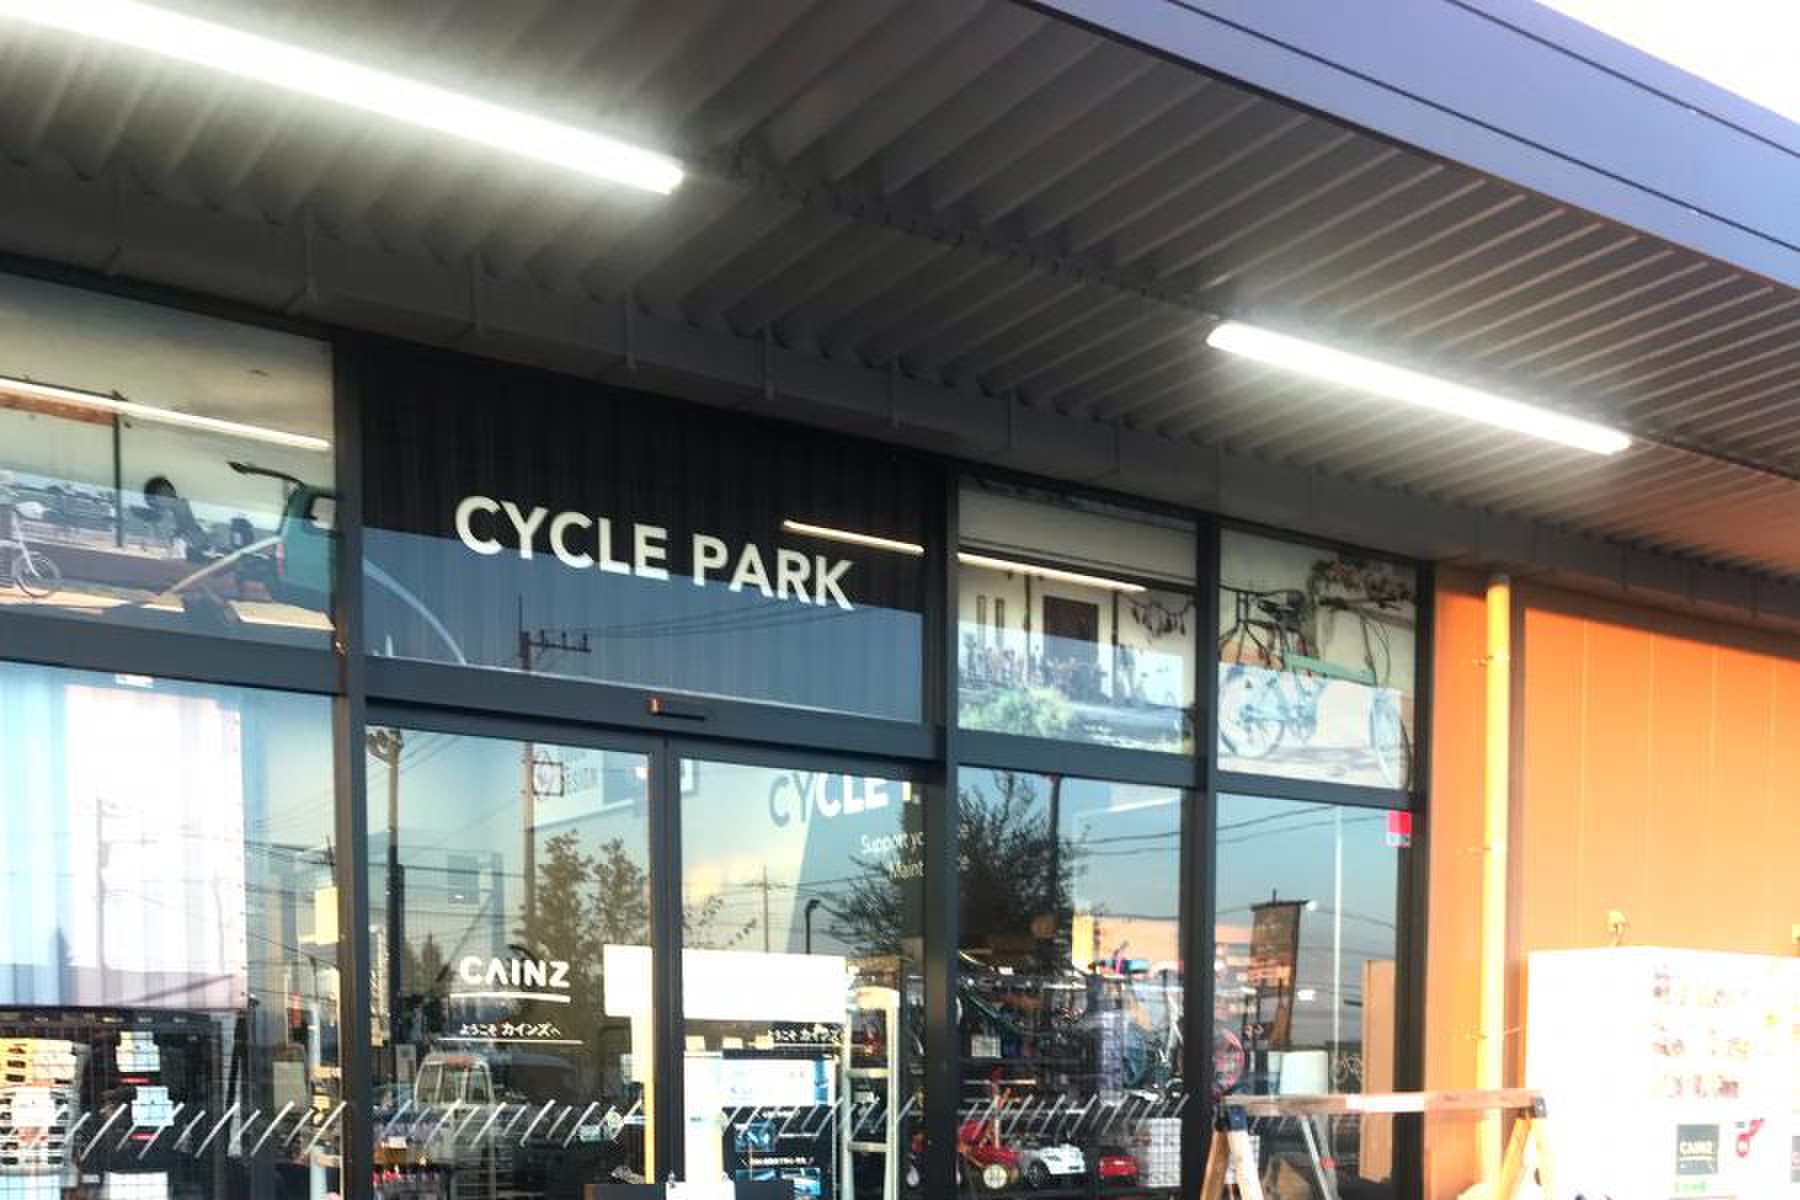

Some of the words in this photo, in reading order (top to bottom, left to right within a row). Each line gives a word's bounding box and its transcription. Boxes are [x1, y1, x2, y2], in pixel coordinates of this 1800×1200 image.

[455, 495, 669, 581] CYCLE
[692, 533, 855, 611] PARK
[769, 772, 888, 827] CYCLE
[459, 955, 570, 988] CAINZ
